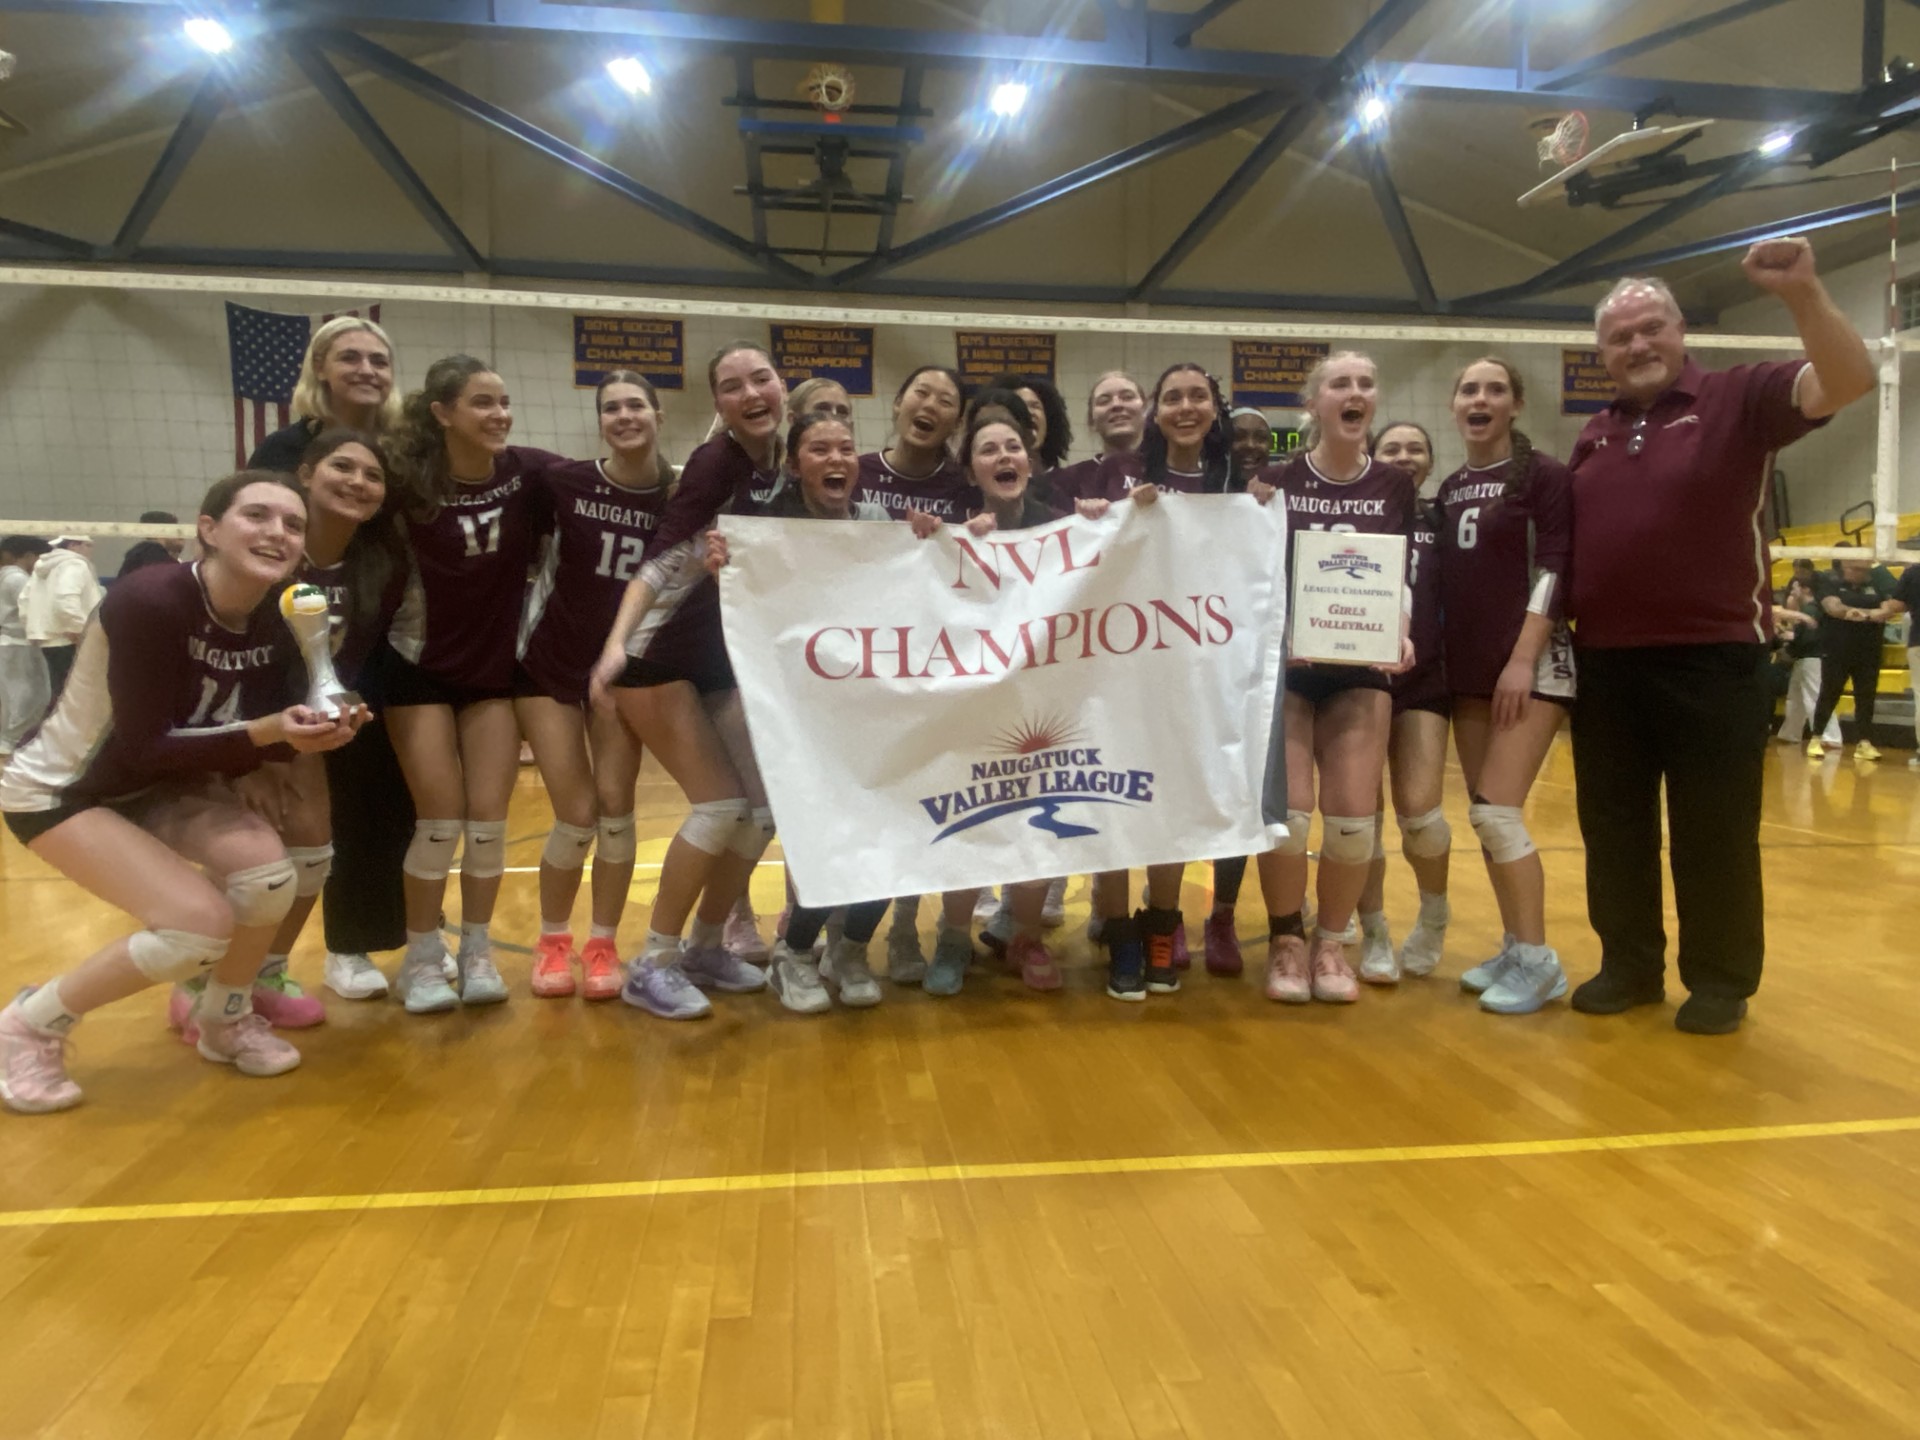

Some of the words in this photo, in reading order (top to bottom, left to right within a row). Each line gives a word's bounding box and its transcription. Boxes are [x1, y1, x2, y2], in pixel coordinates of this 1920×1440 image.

[586, 347, 673, 362] CHAMPIONS
[782, 355, 862, 368] CHAMPIONS
[574, 498, 655, 531] NAUGATU
[861, 488, 955, 515] NAUGATUCK
[1287, 494, 1386, 516] NAUGATUCK
[457, 506, 503, 557] 17
[1457, 506, 1480, 549] 6
[595, 531, 645, 581] 12
[951, 525, 1102, 591] NVL
[1318, 560, 1348, 569] VALLEY
[1350, 560, 1382, 573] LEAGUE
[805, 594, 1234, 681] CHAMPIONS
[971, 748, 1102, 781] NAUGATUCK
[919, 776, 1032, 825] VALLEY
[1038, 770, 1154, 802] LEAGUE
